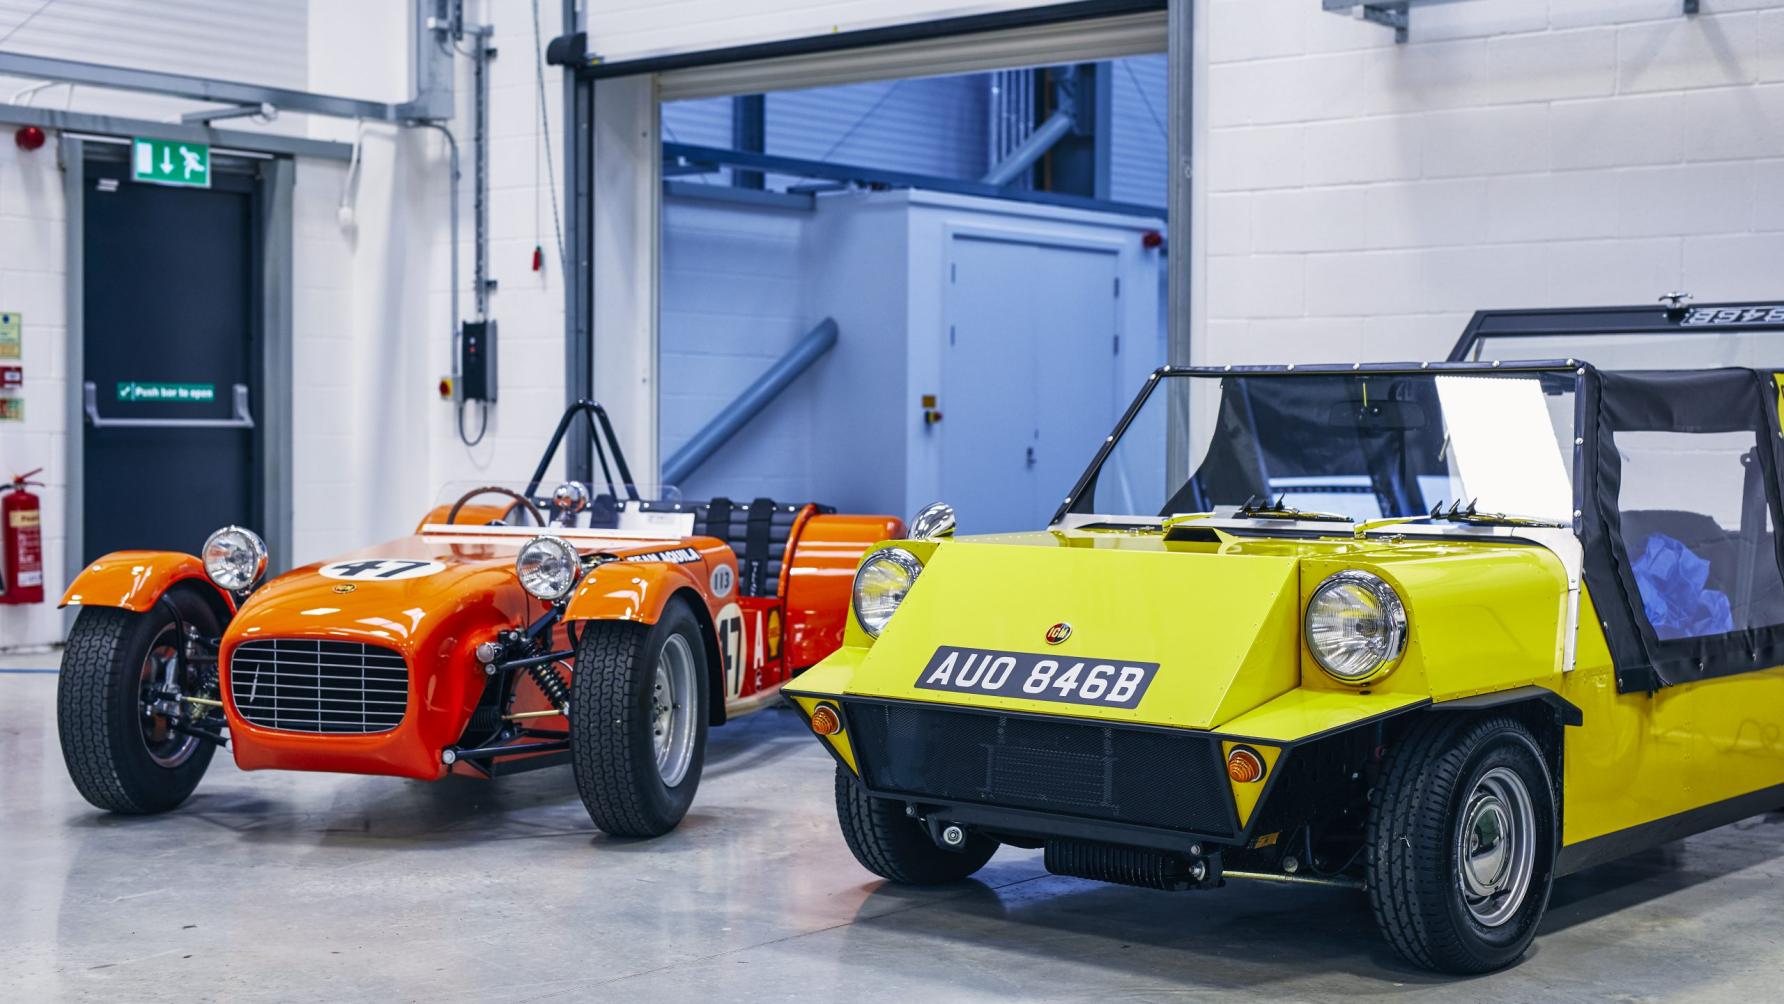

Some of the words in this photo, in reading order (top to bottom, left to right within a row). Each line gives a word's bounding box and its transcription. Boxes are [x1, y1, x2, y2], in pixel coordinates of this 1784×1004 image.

[135, 386, 160, 398] Push
[160, 387, 177, 398] bar
[178, 387, 189, 398] to
[190, 389, 214, 400] open
[626, 552, 663, 562] TEAM
[658, 547, 701, 564] AQUILA
[331, 560, 431, 578] 47
[714, 572, 730, 590] 113
[926, 651, 1017, 690] AUO
[1022, 660, 1145, 703] 846B
